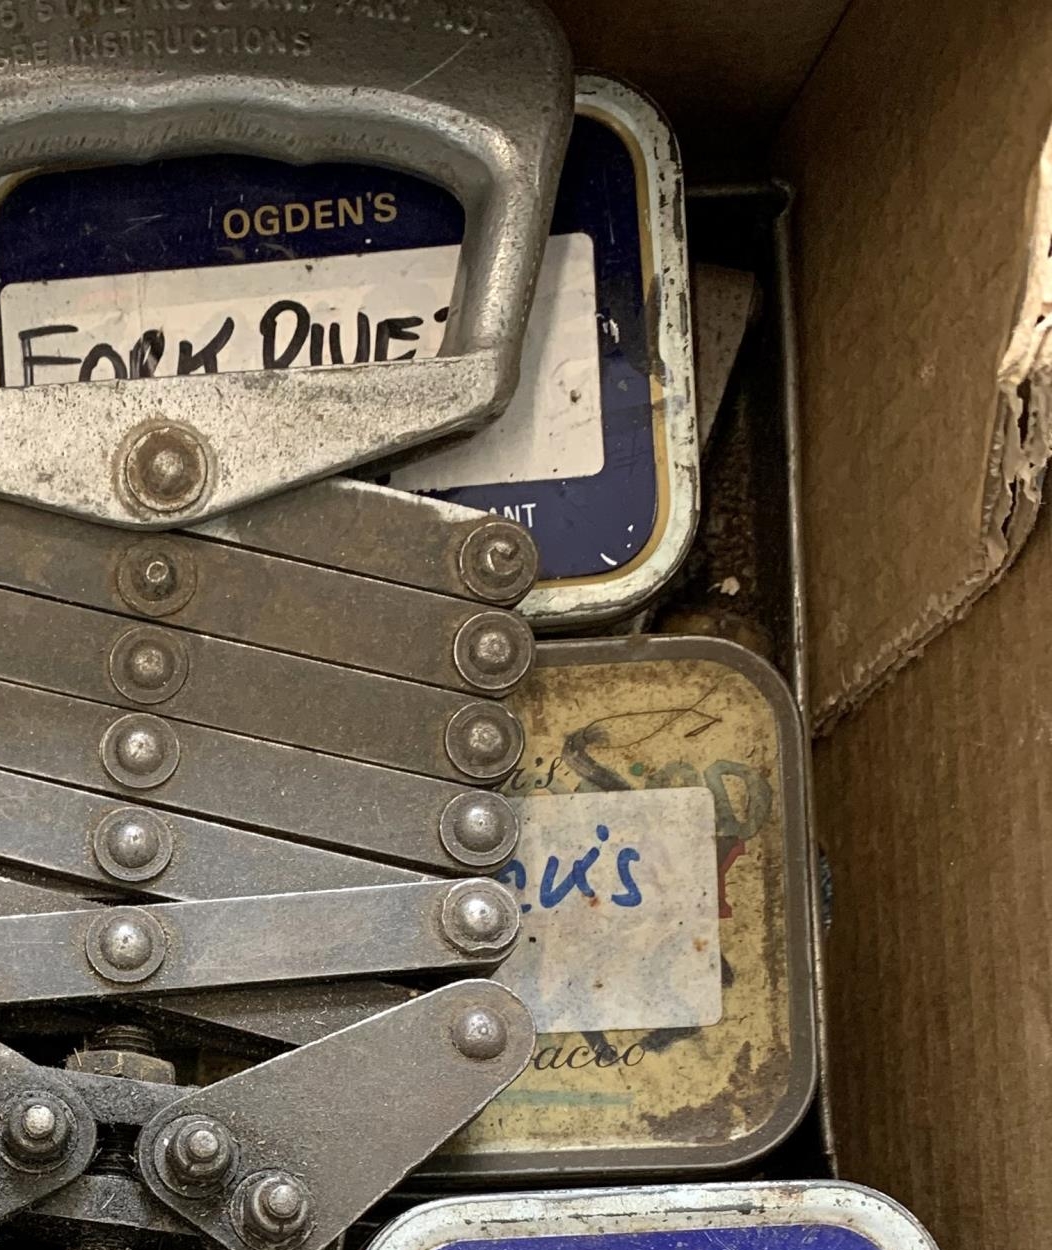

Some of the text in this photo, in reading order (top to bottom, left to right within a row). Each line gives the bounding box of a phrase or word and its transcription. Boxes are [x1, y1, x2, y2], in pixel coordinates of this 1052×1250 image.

[67, 26, 313, 62] INSTRUCTIONS
[222, 191, 398, 241] OGDEN'S
[532, 1042, 646, 1071] acco
